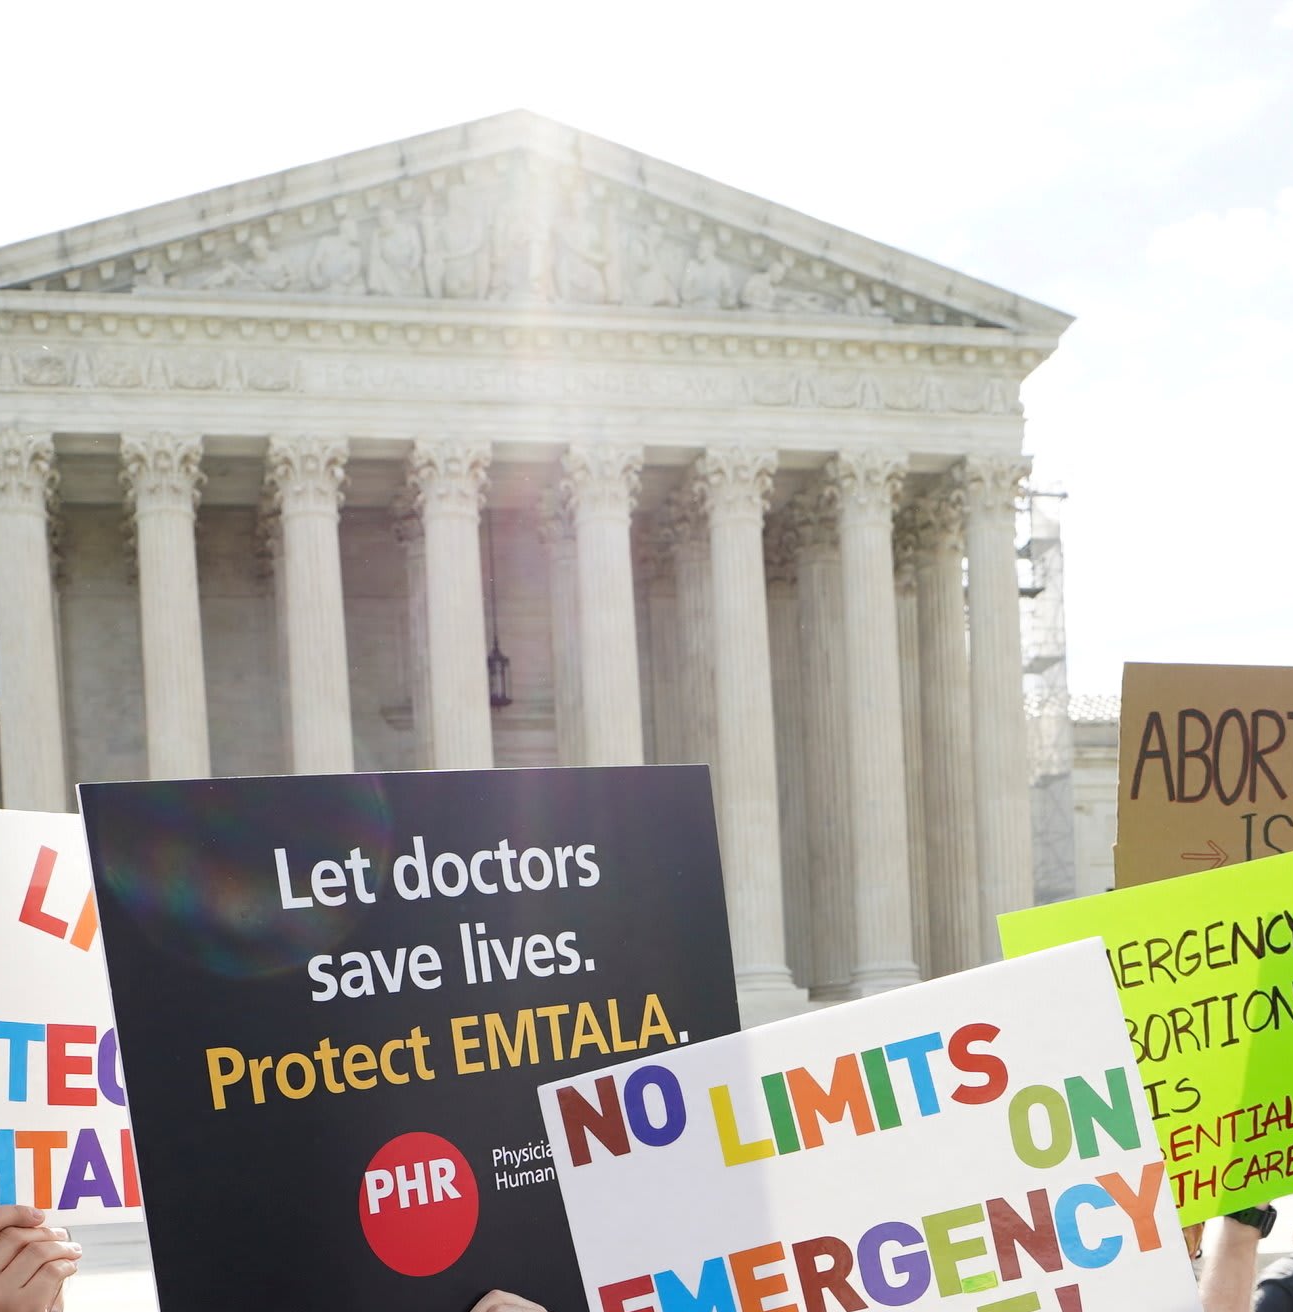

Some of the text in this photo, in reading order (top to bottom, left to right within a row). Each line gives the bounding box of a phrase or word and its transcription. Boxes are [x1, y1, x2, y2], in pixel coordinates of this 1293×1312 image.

[273, 836, 601, 910] Let doctors
[307, 922, 596, 1002] save lives.
[206, 993, 690, 1111] Protect EMTALA.
[556, 1022, 1142, 1169] NO LIMITS ON
[1144, 1077, 1202, 1121] IS
[364, 1158, 462, 1215] PHR
[495, 1167, 555, 1191] Human
